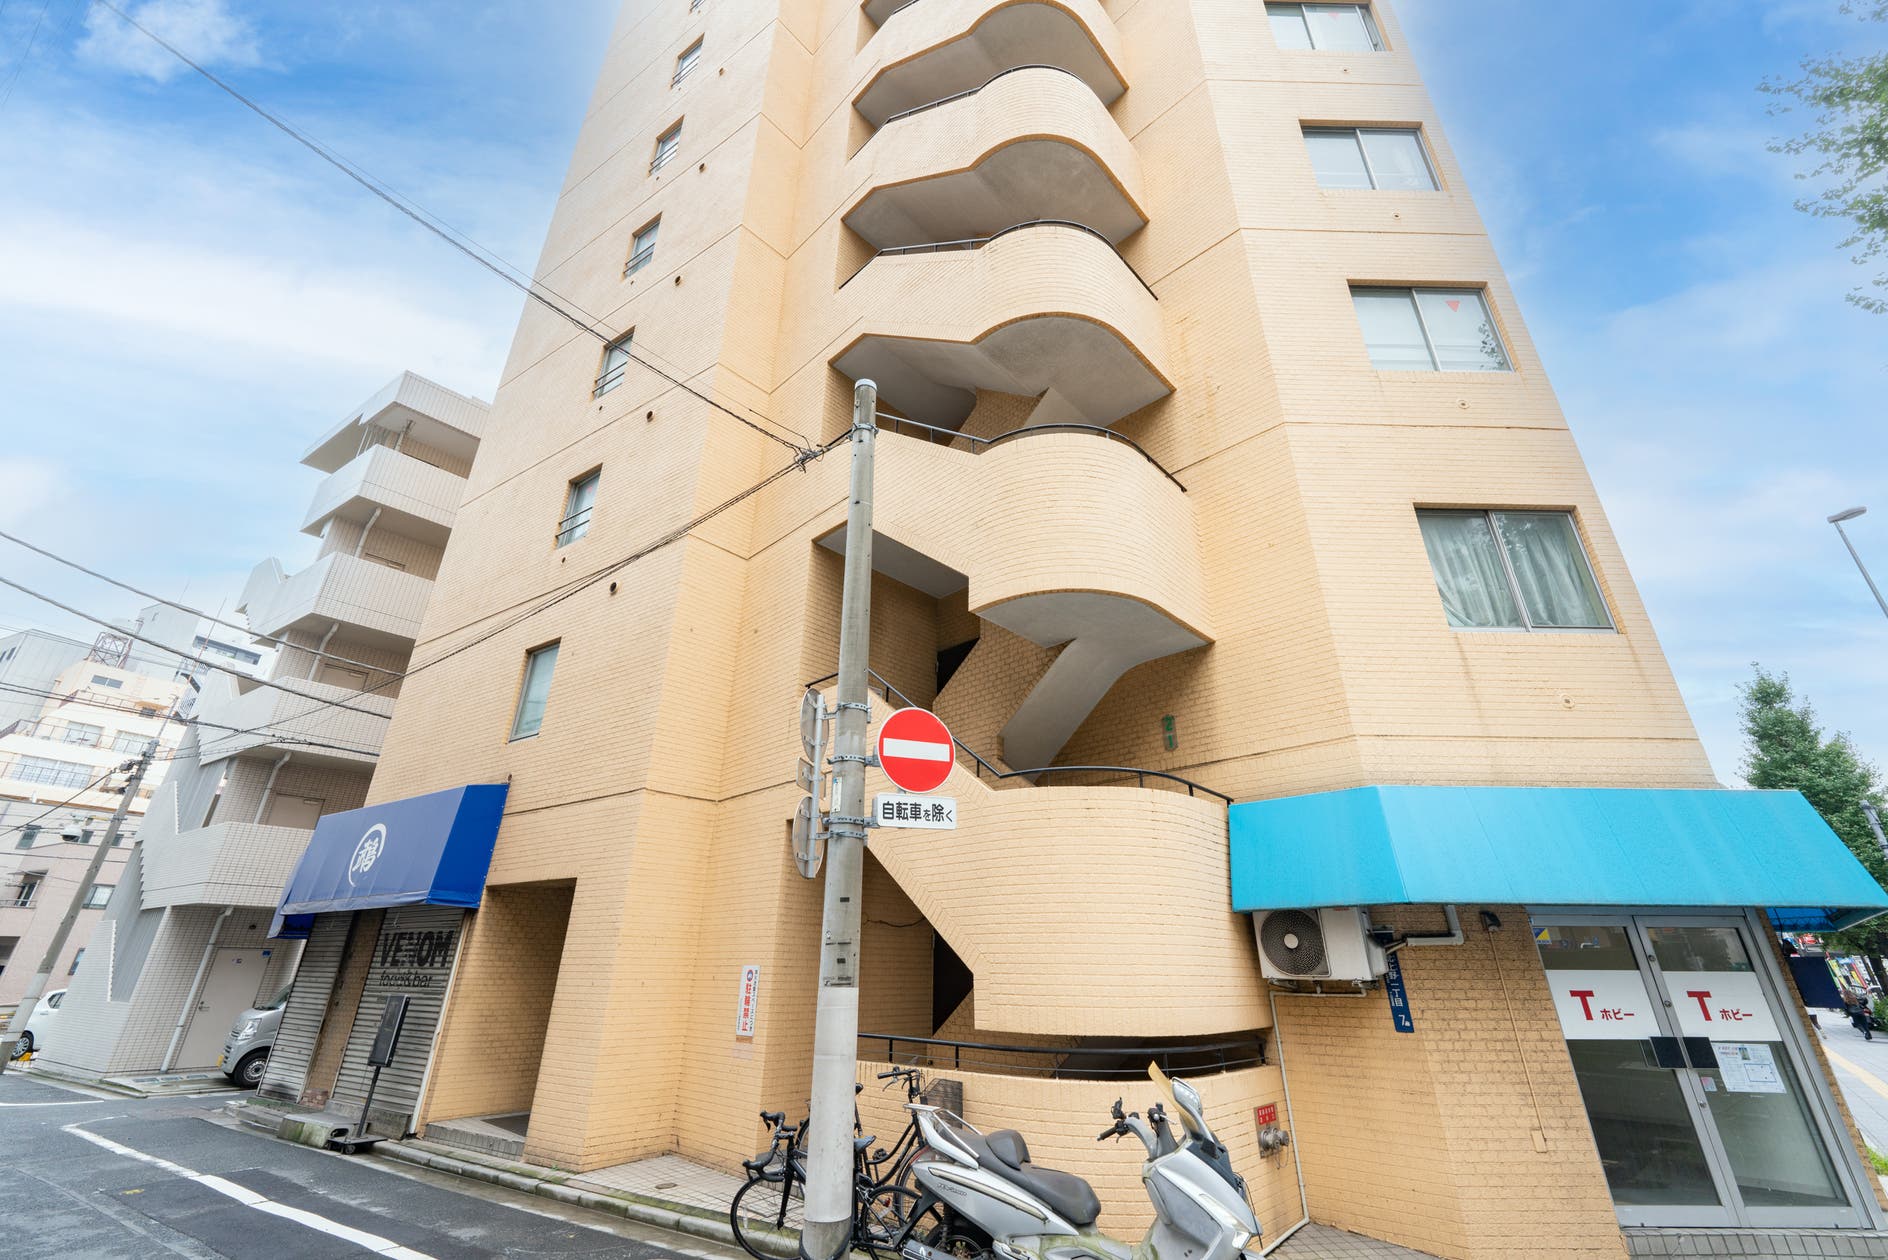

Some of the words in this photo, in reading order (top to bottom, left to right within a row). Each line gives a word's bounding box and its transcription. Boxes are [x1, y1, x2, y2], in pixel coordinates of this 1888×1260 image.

[882, 801, 953, 822] 自転車を除く
[1569, 990, 1595, 1021] T
[1600, 1009, 1635, 1021] ホビー
[1686, 991, 1712, 1021] T
[1719, 1009, 1753, 1021] ホビー
